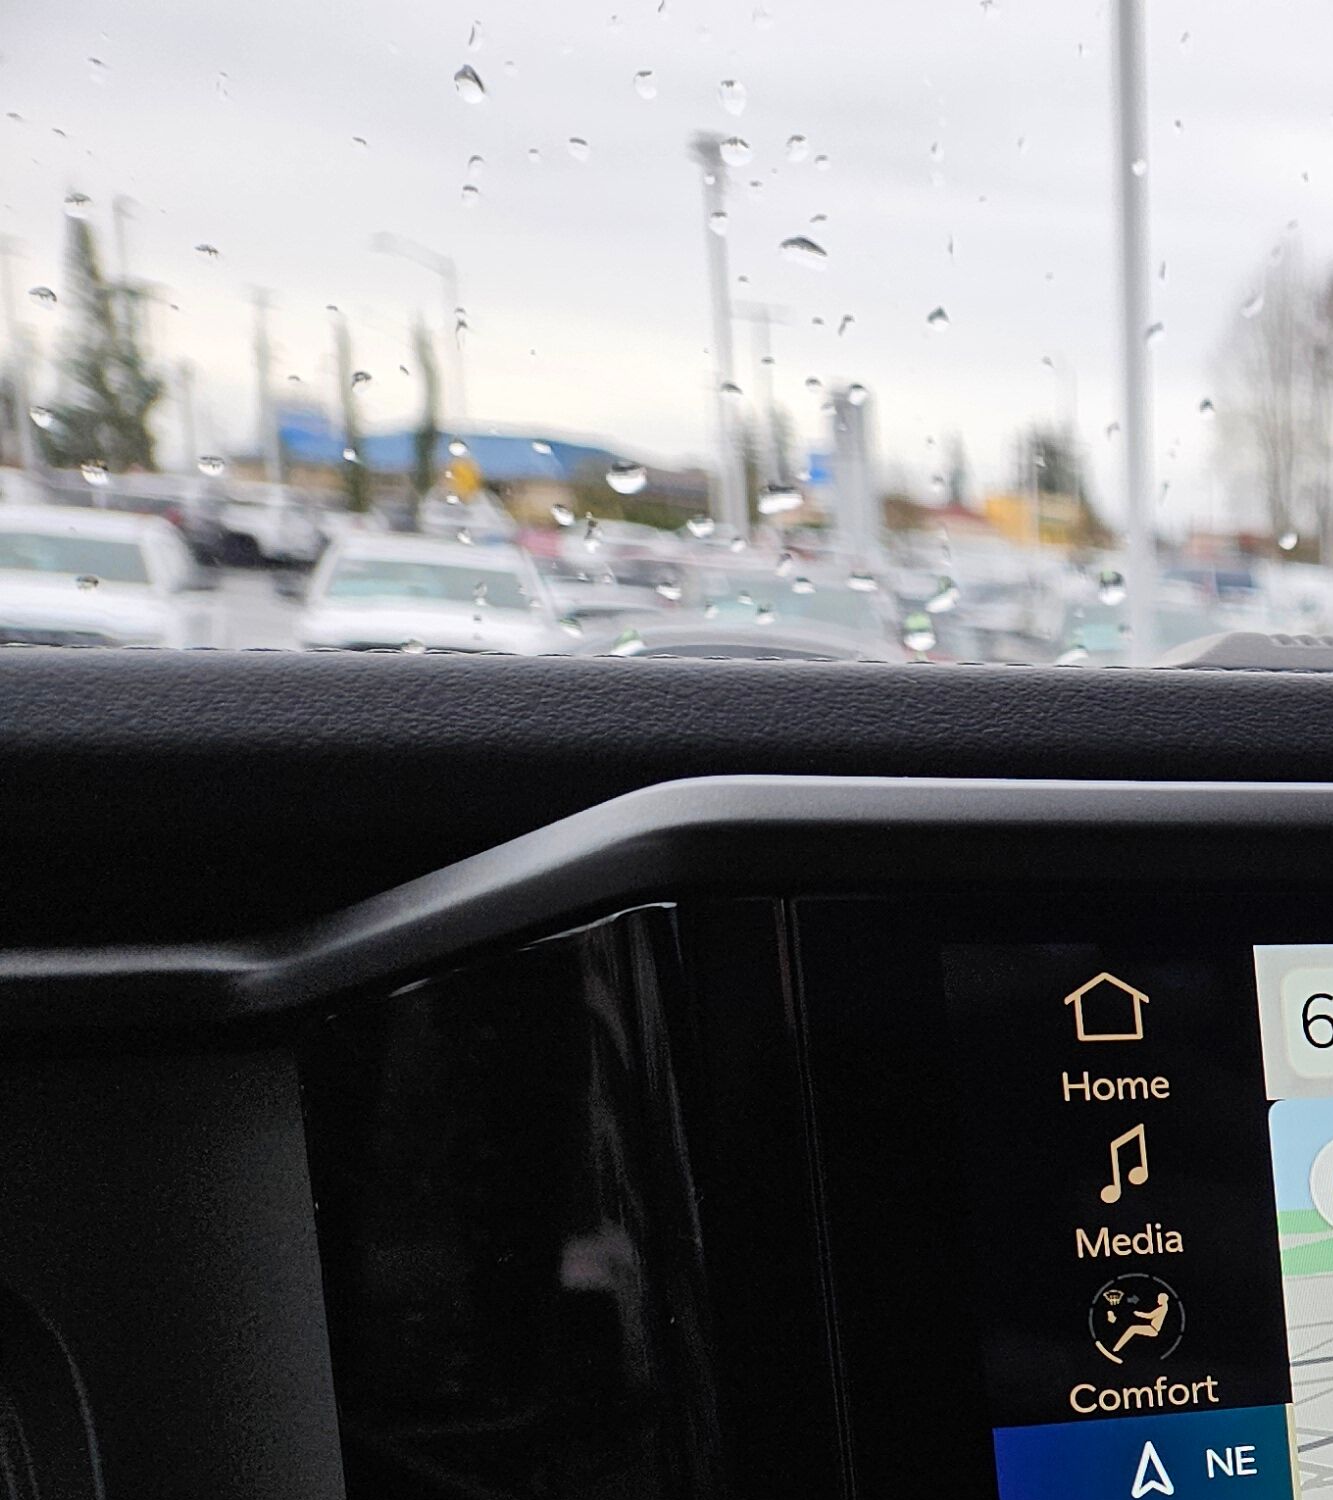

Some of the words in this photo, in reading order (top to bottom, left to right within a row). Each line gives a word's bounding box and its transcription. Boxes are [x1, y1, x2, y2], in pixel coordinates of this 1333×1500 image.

[1062, 1070, 1171, 1101] Home
[1075, 1224, 1184, 1259] Media
[1069, 1375, 1219, 1414] Comfort
[1206, 1445, 1258, 1478] NE
